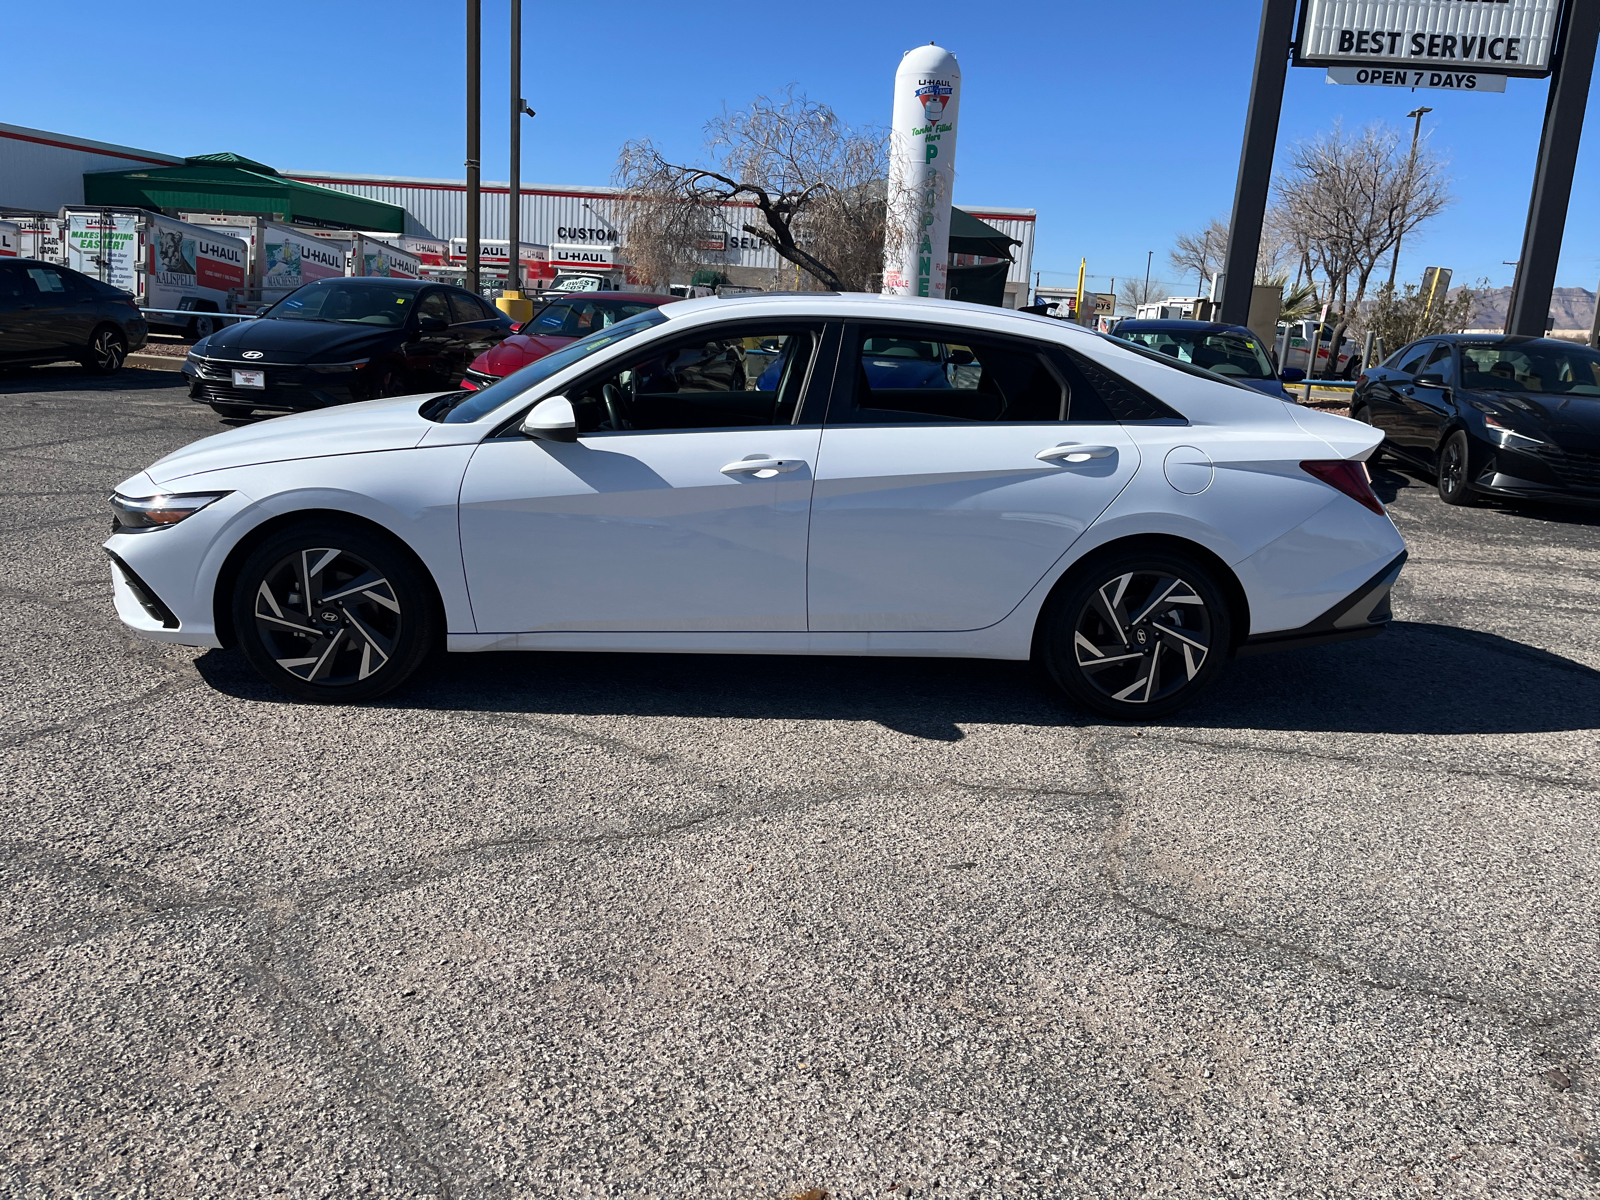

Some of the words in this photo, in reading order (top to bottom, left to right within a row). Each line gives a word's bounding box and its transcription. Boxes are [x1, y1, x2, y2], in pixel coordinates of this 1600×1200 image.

[1338, 30, 1401, 55] BEST
[1411, 33, 1521, 61] SERVICE
[918, 79, 951, 87] U-HAUL
[1356, 69, 1407, 85] OPEN
[1413, 72, 1424, 86] 7
[1429, 73, 1477, 89] DAYS
[919, 86, 934, 94] OPEN
[912, 124, 932, 136] Tanks
[935, 122, 952, 133] Filled
[925, 134, 941, 143] Here
[918, 144, 938, 297] PROPANE
[71, 231, 99, 239] MAKES
[557, 226, 618, 241] CUSTOM
[44, 237, 59, 245] CARG
[39, 246, 59, 255] CAPAC
[199, 241, 241, 263] U-HAUL
[415, 243, 438, 253] U-HAUL
[458, 245, 507, 256] UAUL
[301, 245, 341, 268] U-HAUL
[527, 250, 545, 260] U-HAUL
[558, 251, 607, 262] U-HAUL
[390, 256, 419, 276] U-HAUL
[156, 271, 194, 287] KALISPELL
[267, 276, 299, 287] MANCHESTER
[561, 280, 597, 288] LOWEST
